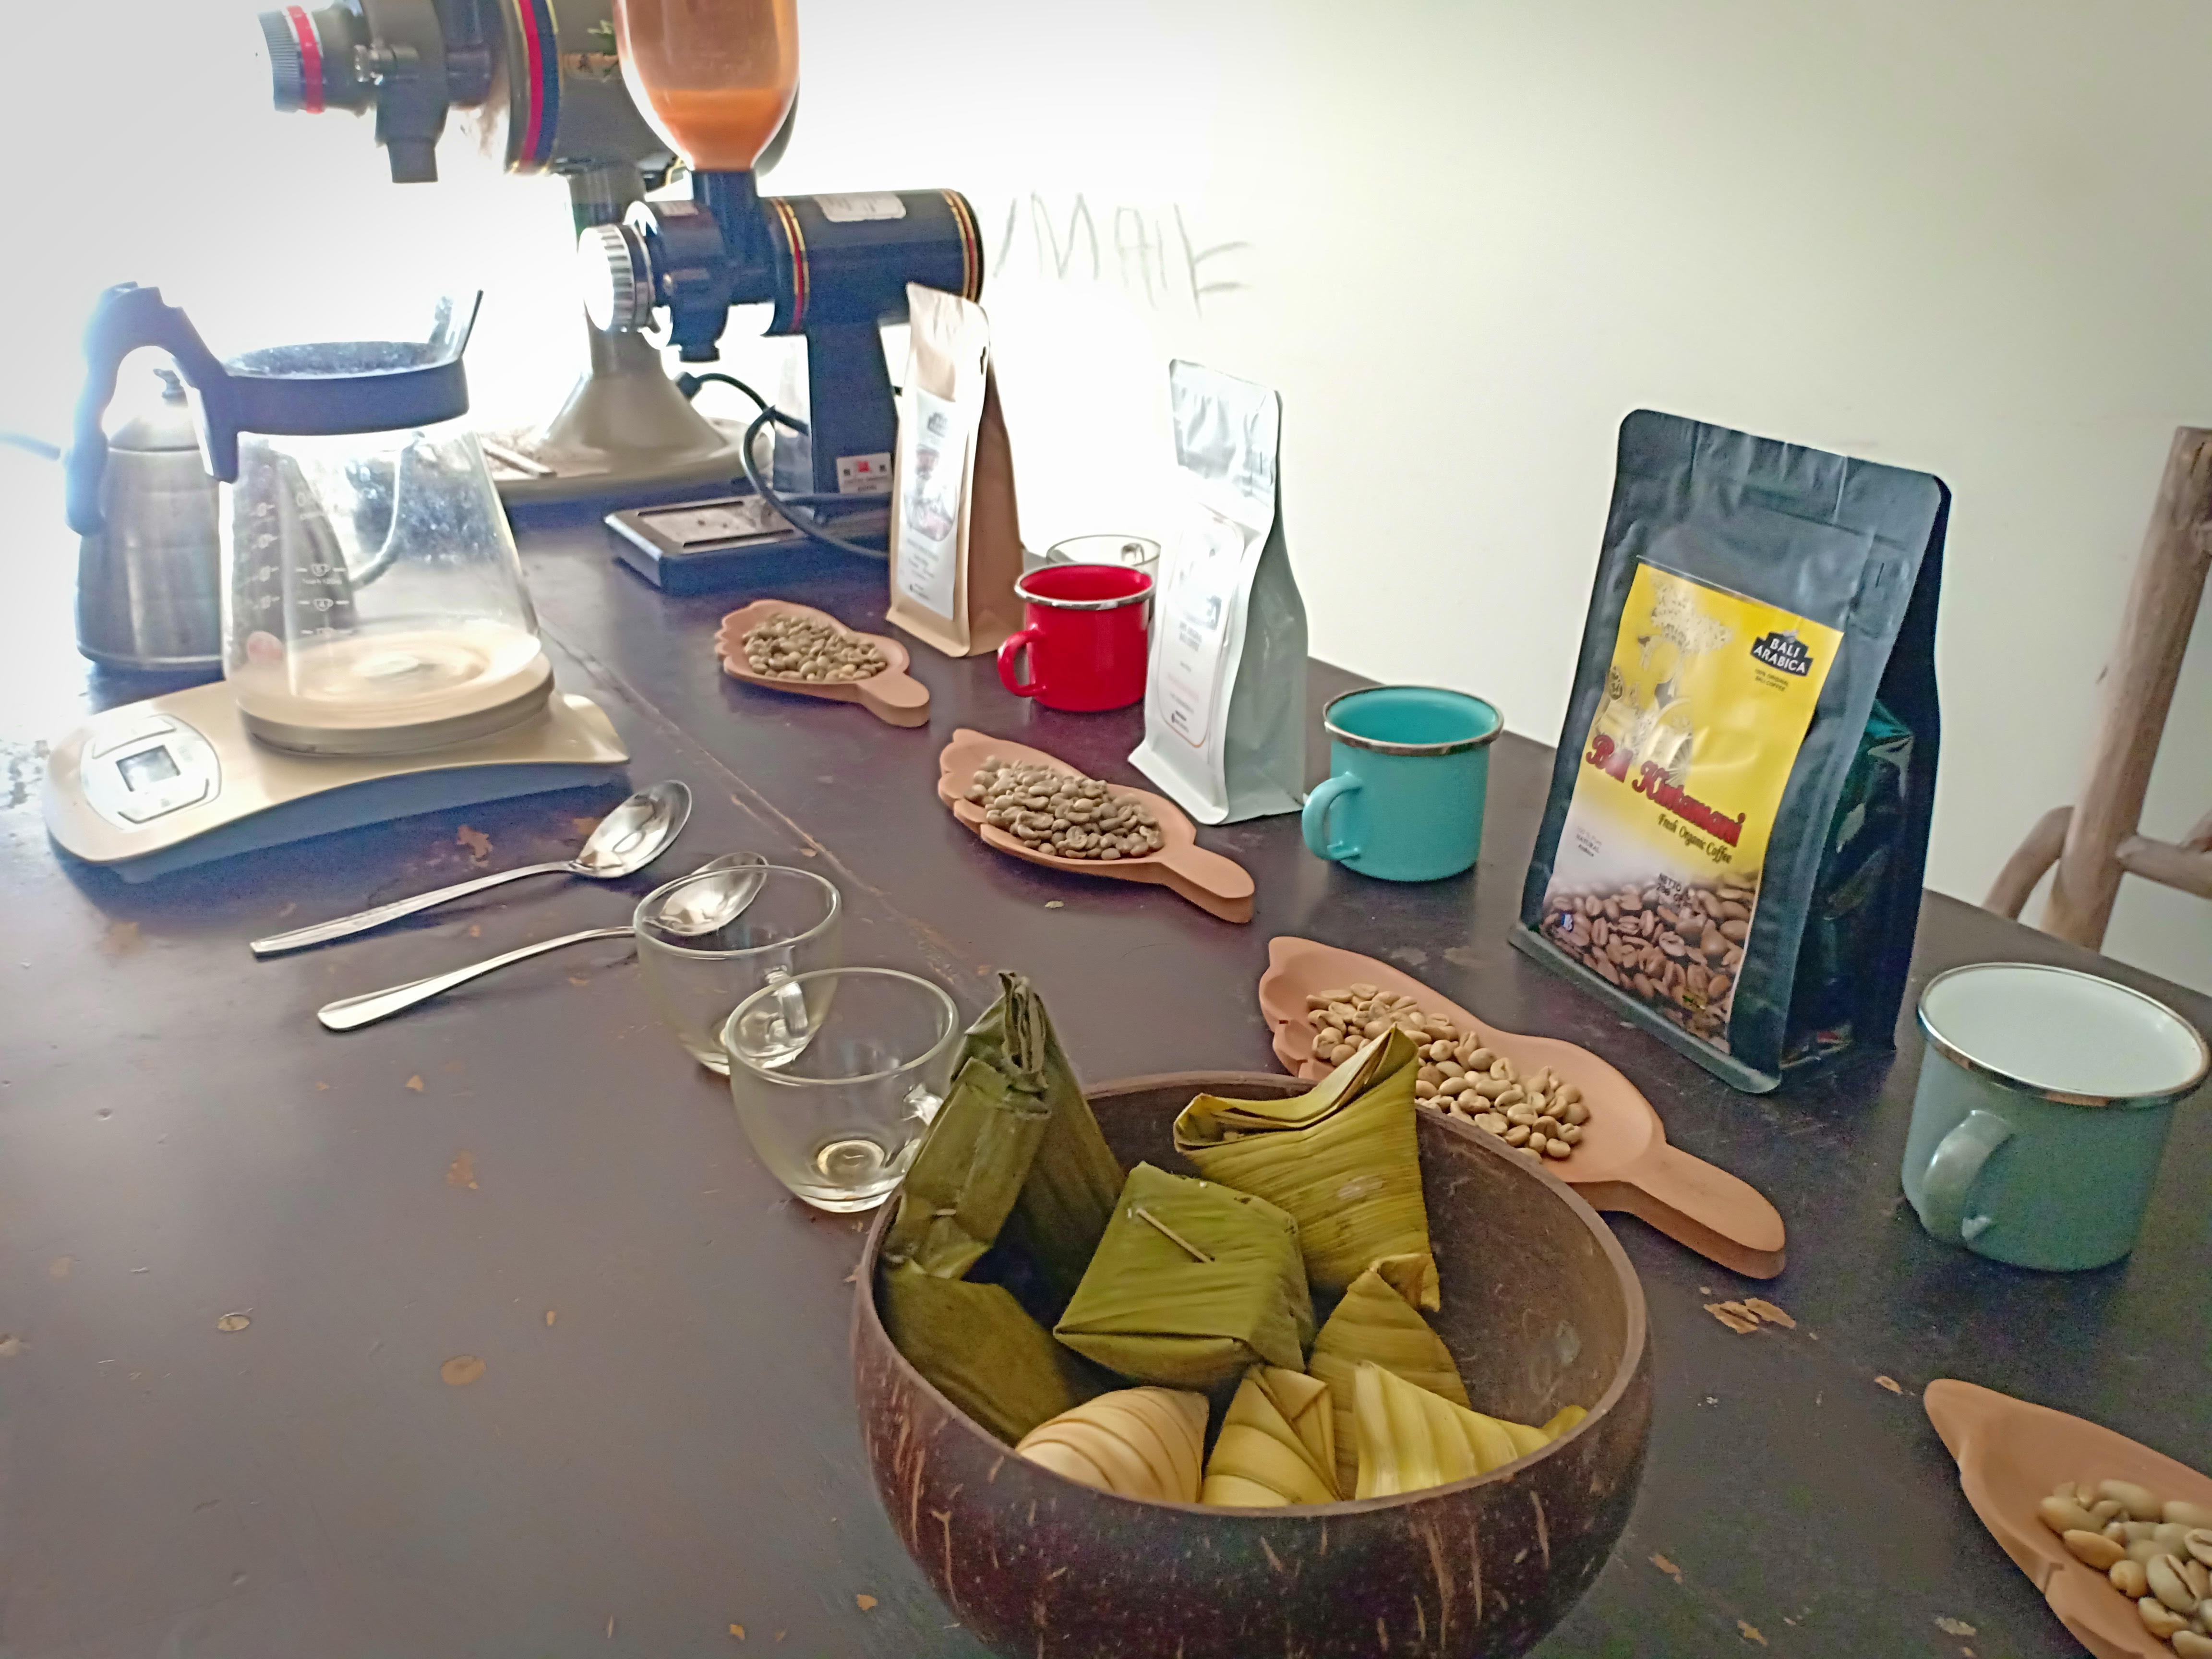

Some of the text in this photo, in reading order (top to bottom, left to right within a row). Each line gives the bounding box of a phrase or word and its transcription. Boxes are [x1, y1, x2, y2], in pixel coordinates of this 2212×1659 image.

[1753, 645, 1806, 673] ARABICA
[1770, 638, 1801, 658] BALI
[1632, 760, 1746, 847] Kintamani
[1679, 825, 1707, 850] Organic
[1706, 842, 1732, 864] Coffee
